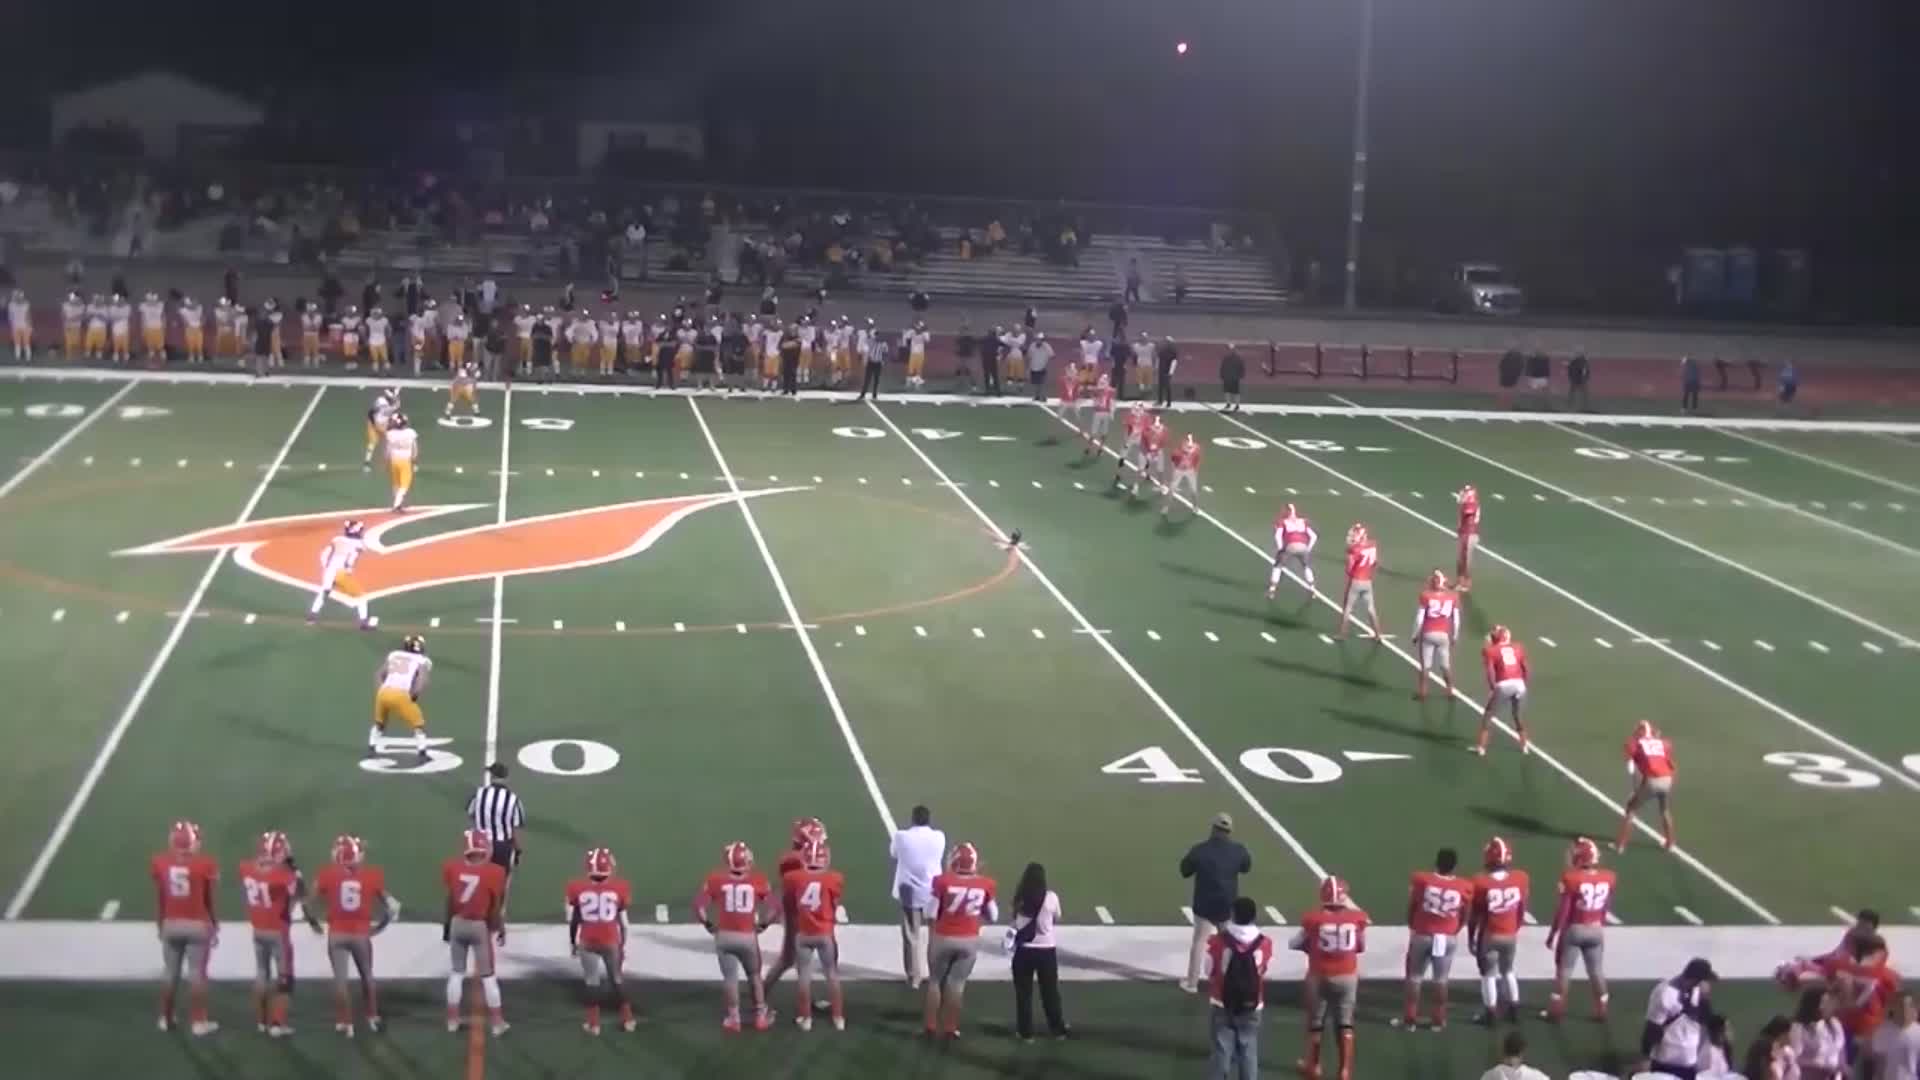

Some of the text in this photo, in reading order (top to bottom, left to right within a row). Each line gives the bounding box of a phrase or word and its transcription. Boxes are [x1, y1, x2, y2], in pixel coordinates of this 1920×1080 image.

[1428, 599, 1453, 618] 24
[169, 866, 190, 897] 5
[244, 877, 271, 908] 21
[341, 880, 361, 911] 6
[459, 873, 481, 904] 7
[801, 881, 822, 911] 4
[579, 891, 618, 922] 26
[721, 883, 755, 913] 10
[947, 885, 985, 916] 72
[1319, 923, 1356, 952] 50
